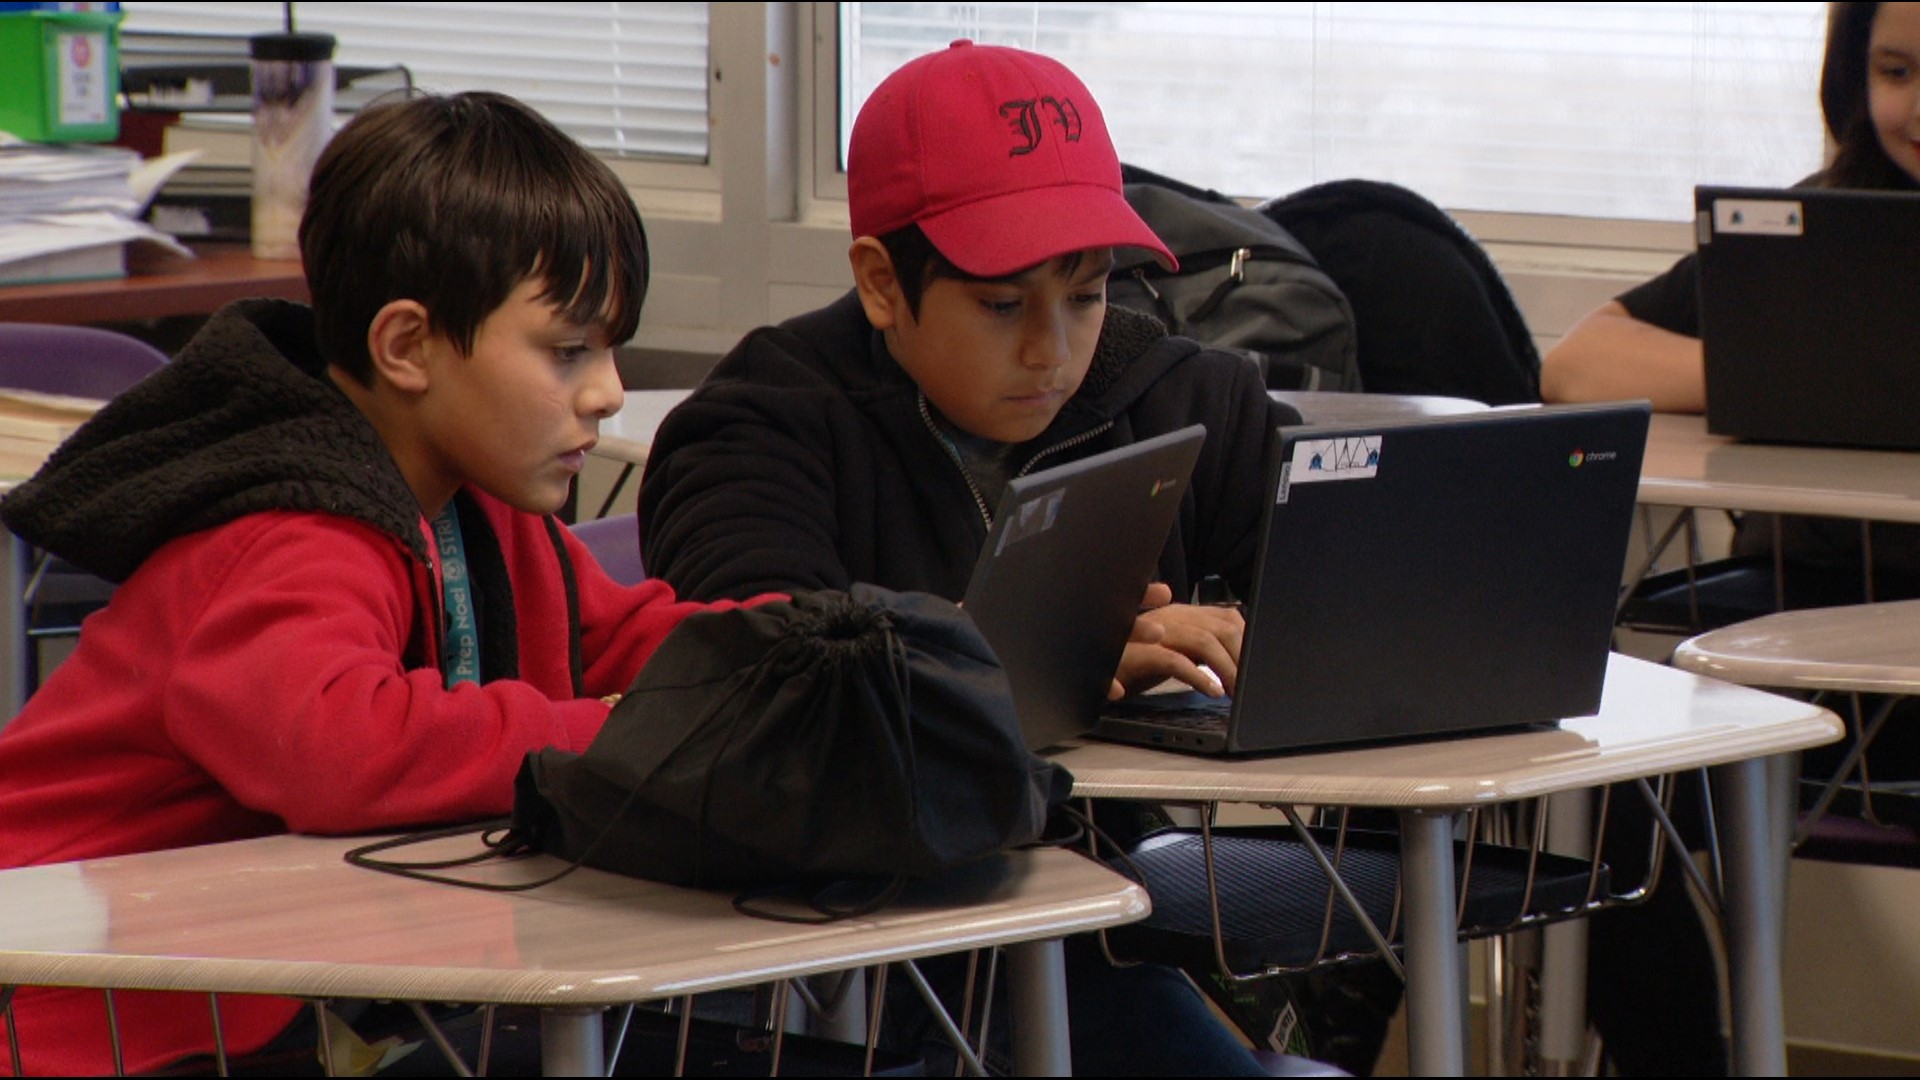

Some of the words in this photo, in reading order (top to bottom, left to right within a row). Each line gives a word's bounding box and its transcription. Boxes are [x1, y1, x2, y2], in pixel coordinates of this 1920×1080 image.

[1585, 451, 1617, 462] chrome
[450, 586, 470, 629] Noel
[456, 634, 475, 676] Prep
